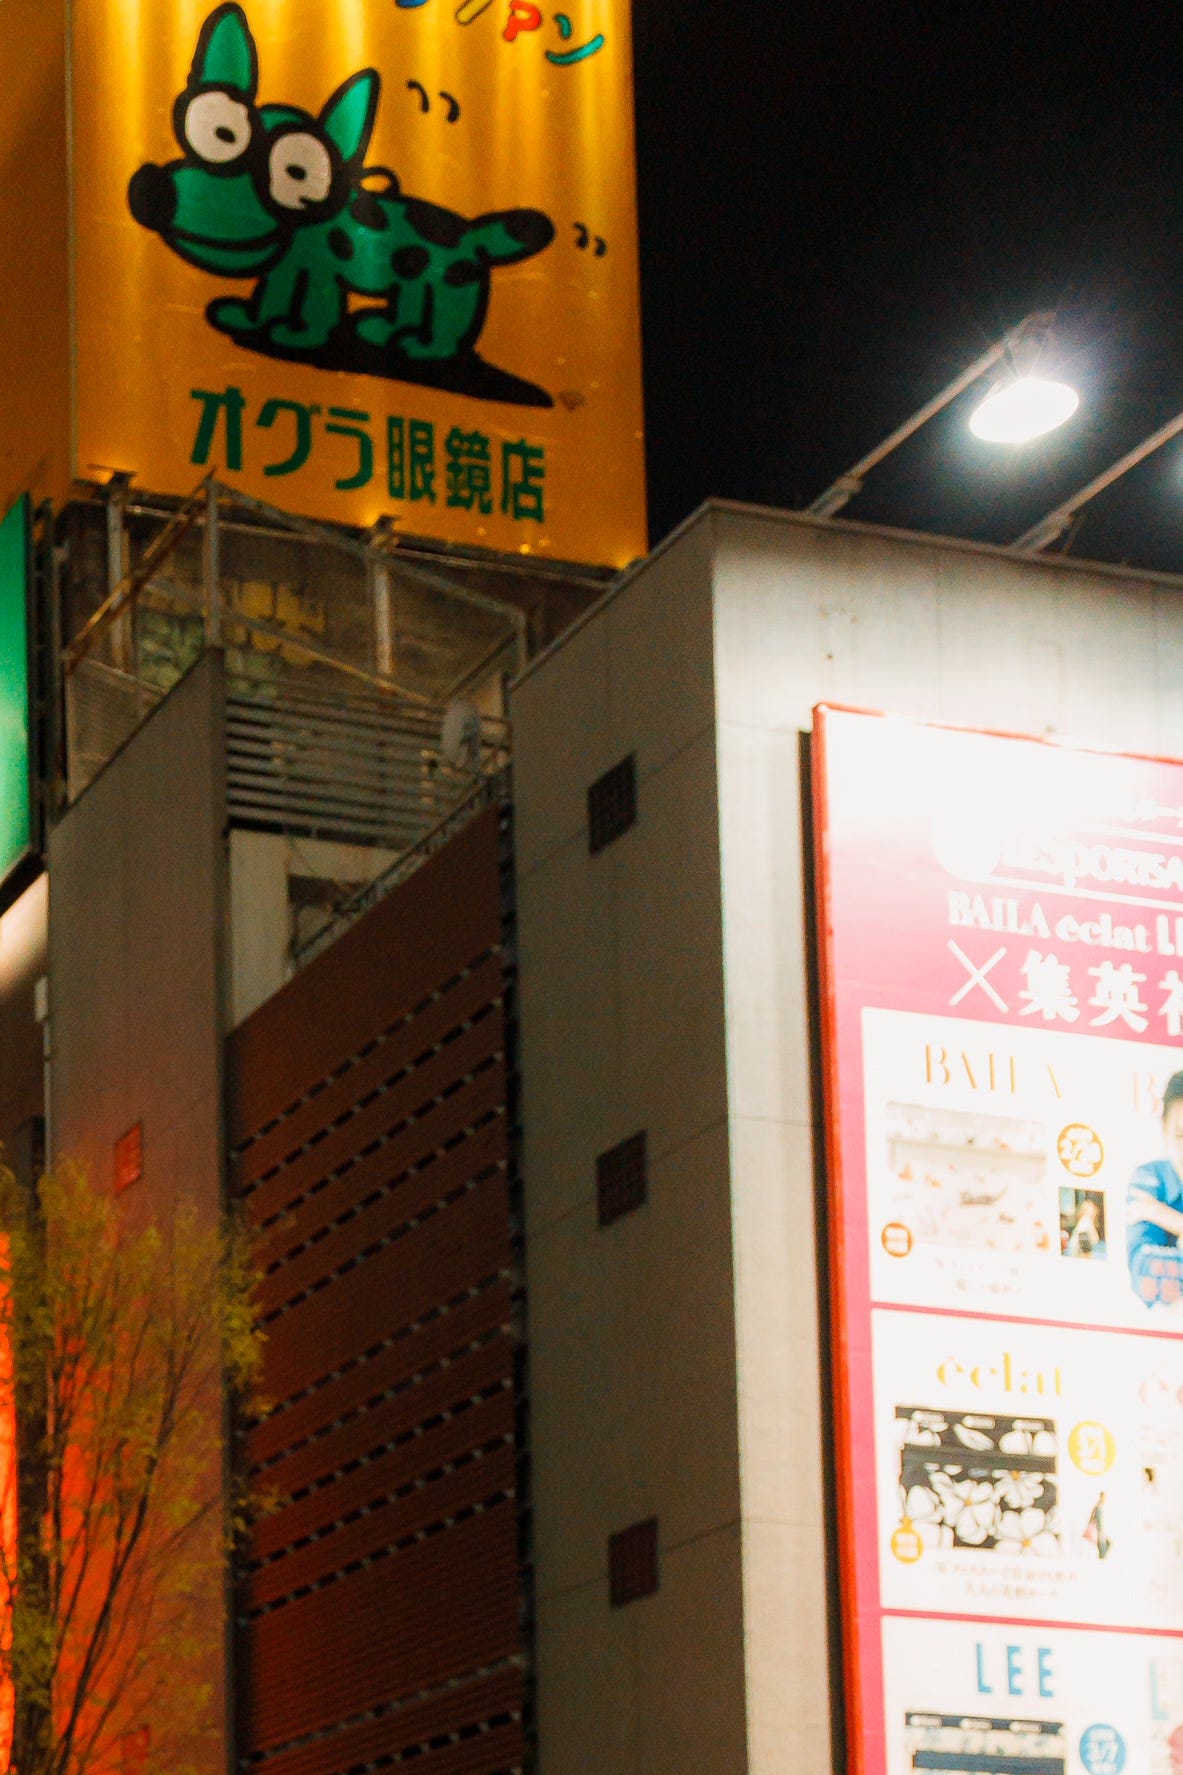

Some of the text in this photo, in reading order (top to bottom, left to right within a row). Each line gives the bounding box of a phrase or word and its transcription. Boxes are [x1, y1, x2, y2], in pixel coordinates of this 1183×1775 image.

[190, 386, 546, 523] オグラ眼鏡店
[976, 1642, 1055, 1698] LEE
